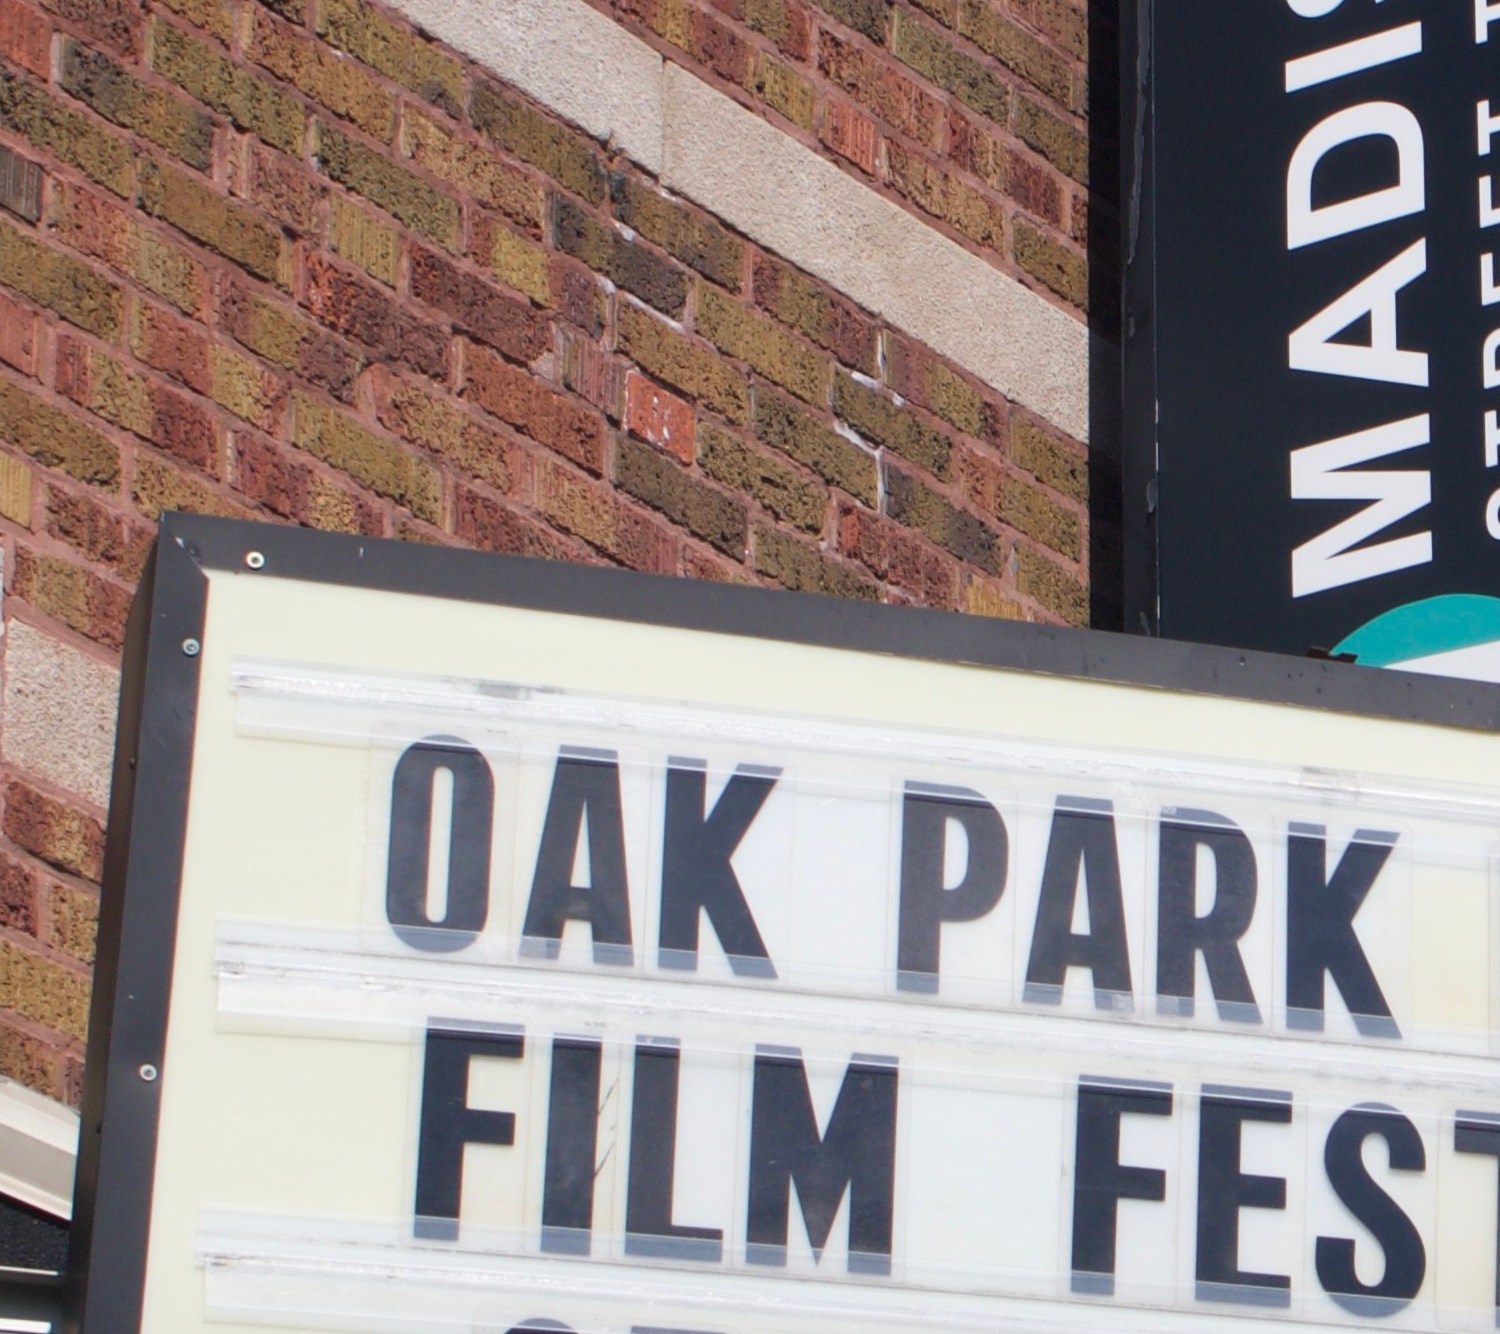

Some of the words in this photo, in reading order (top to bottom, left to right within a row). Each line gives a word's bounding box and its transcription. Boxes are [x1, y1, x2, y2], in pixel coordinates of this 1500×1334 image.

[384, 734, 781, 979] OAK
[895, 779, 1400, 1039] PARK
[412, 1015, 900, 1276] FILM
